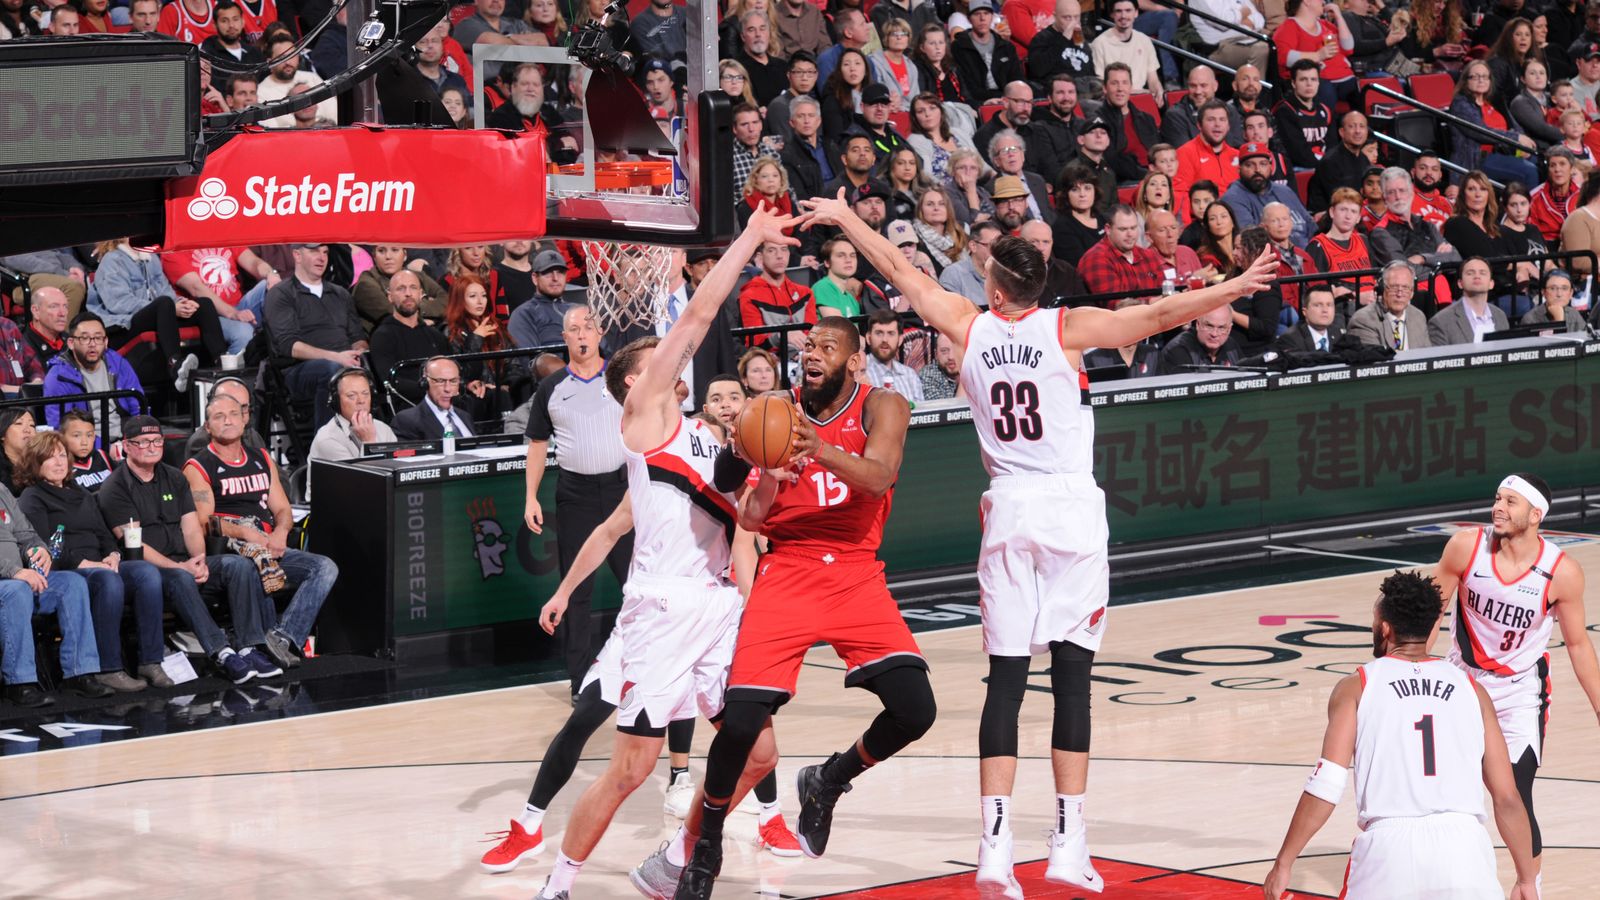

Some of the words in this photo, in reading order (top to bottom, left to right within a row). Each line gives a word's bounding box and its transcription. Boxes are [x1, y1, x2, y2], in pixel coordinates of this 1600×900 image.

[982, 344, 1043, 370] COLLINS
[990, 380, 1043, 442] 33
[1295, 387, 1488, 495] 建网站
[810, 471, 849, 507] 15
[1467, 588, 1535, 630] BLAZERS
[1500, 630, 1527, 652] 31
[1388, 678, 1456, 702] TURNER
[1414, 714, 1437, 777] 1
